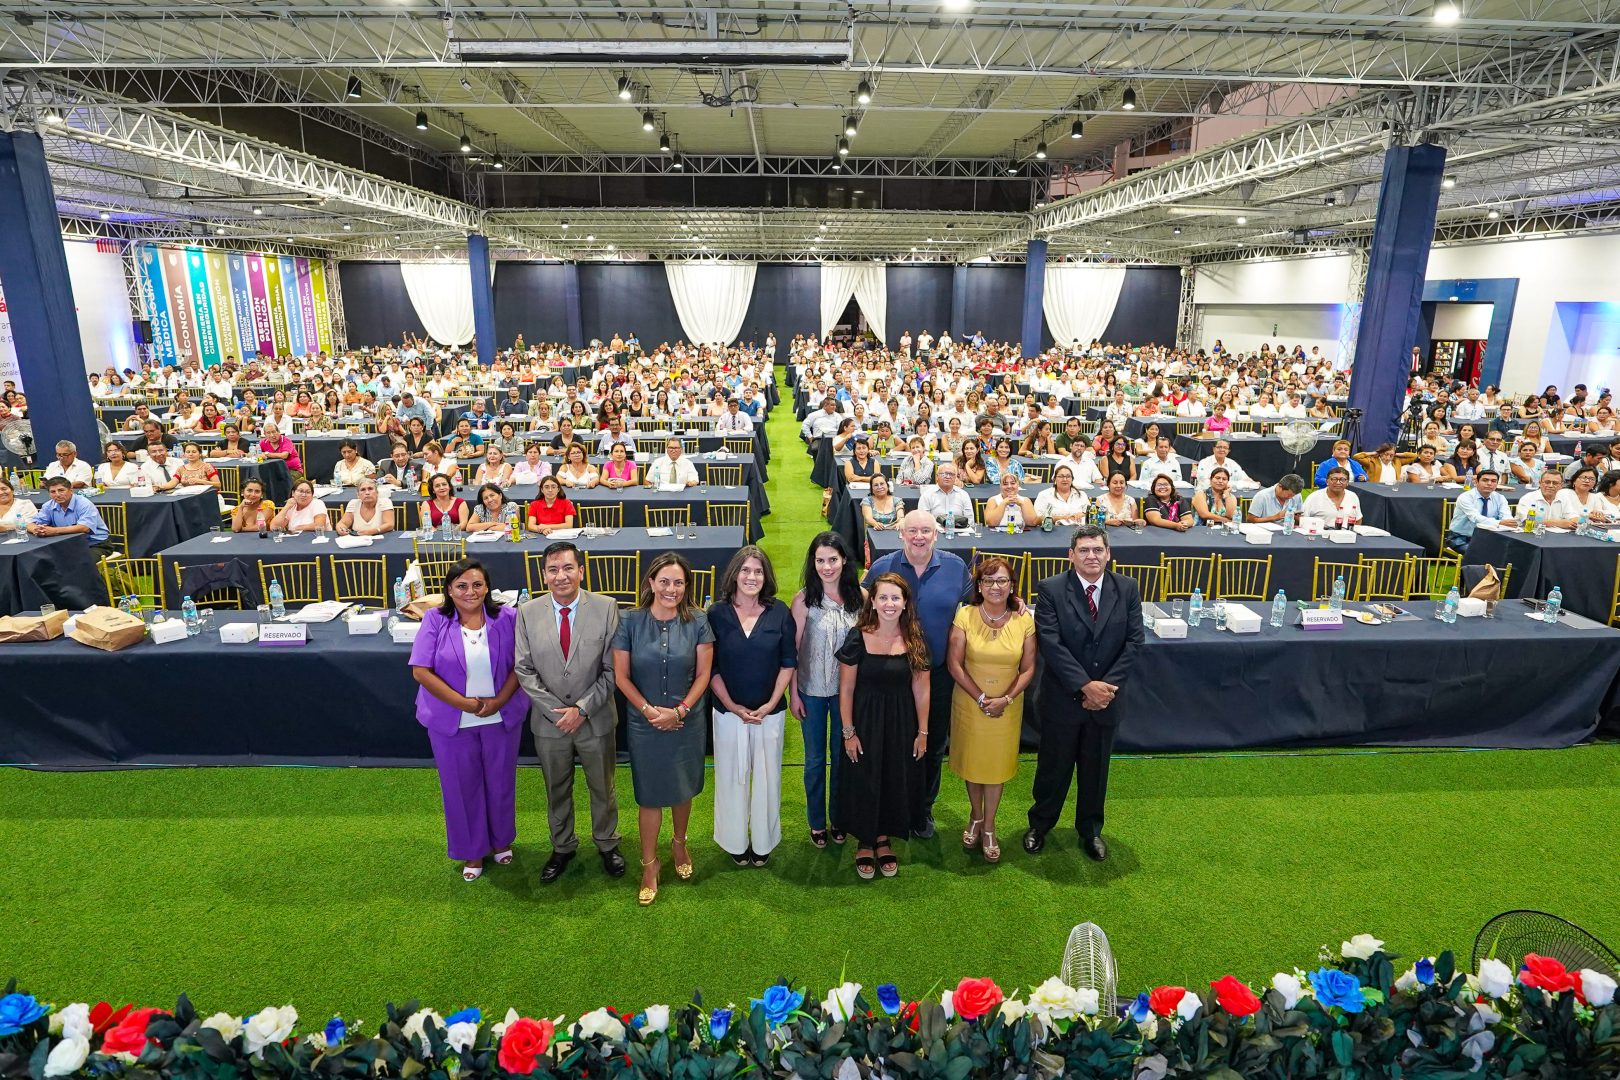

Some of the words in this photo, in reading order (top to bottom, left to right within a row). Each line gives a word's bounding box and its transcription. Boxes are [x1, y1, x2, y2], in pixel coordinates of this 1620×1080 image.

[174, 285, 192, 356] ECONOMÍA
[195, 293, 202, 305] EN
[199, 281, 215, 355] CIBERSEGURIDAD
[221, 295, 233, 345] MARKETING
[253, 297, 265, 342] GESTIÓN
[260, 298, 271, 342] PÚBLICA
[160, 310, 174, 358] MÉDICA
[198, 307, 210, 355] INGENIERÍA
[273, 307, 283, 349] INGENIERÍA
